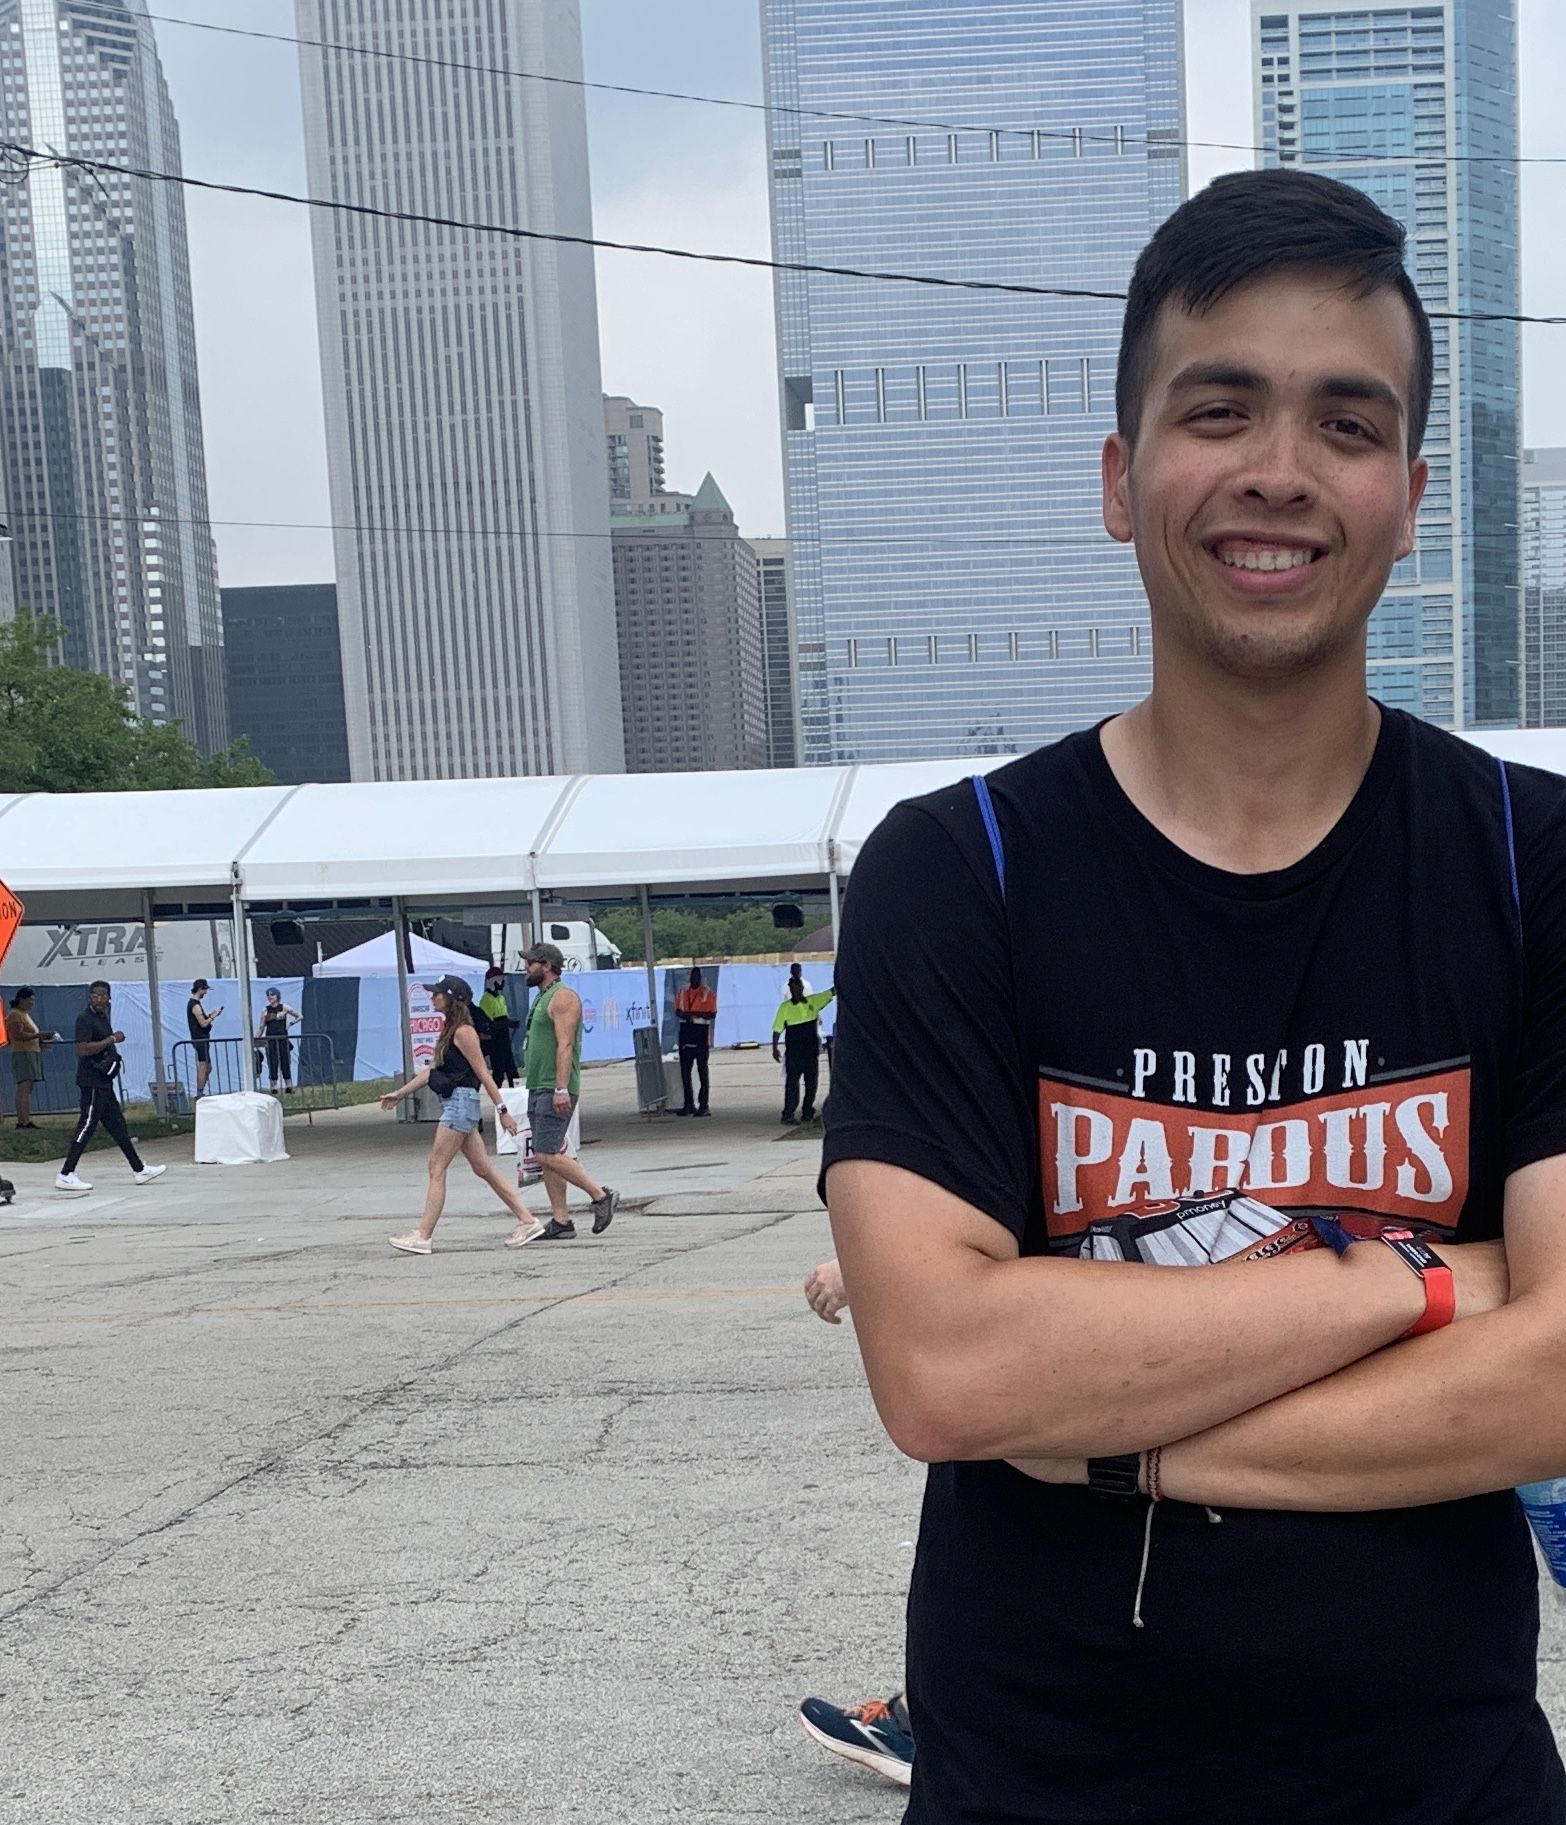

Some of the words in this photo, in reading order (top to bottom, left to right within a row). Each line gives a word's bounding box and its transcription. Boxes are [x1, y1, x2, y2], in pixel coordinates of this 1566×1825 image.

[0, 901, 17, 920] ON
[37, 924, 150, 968] XTRA
[626, 1001, 653, 1025] xfinit
[410, 1017, 441, 1033] HICAGO
